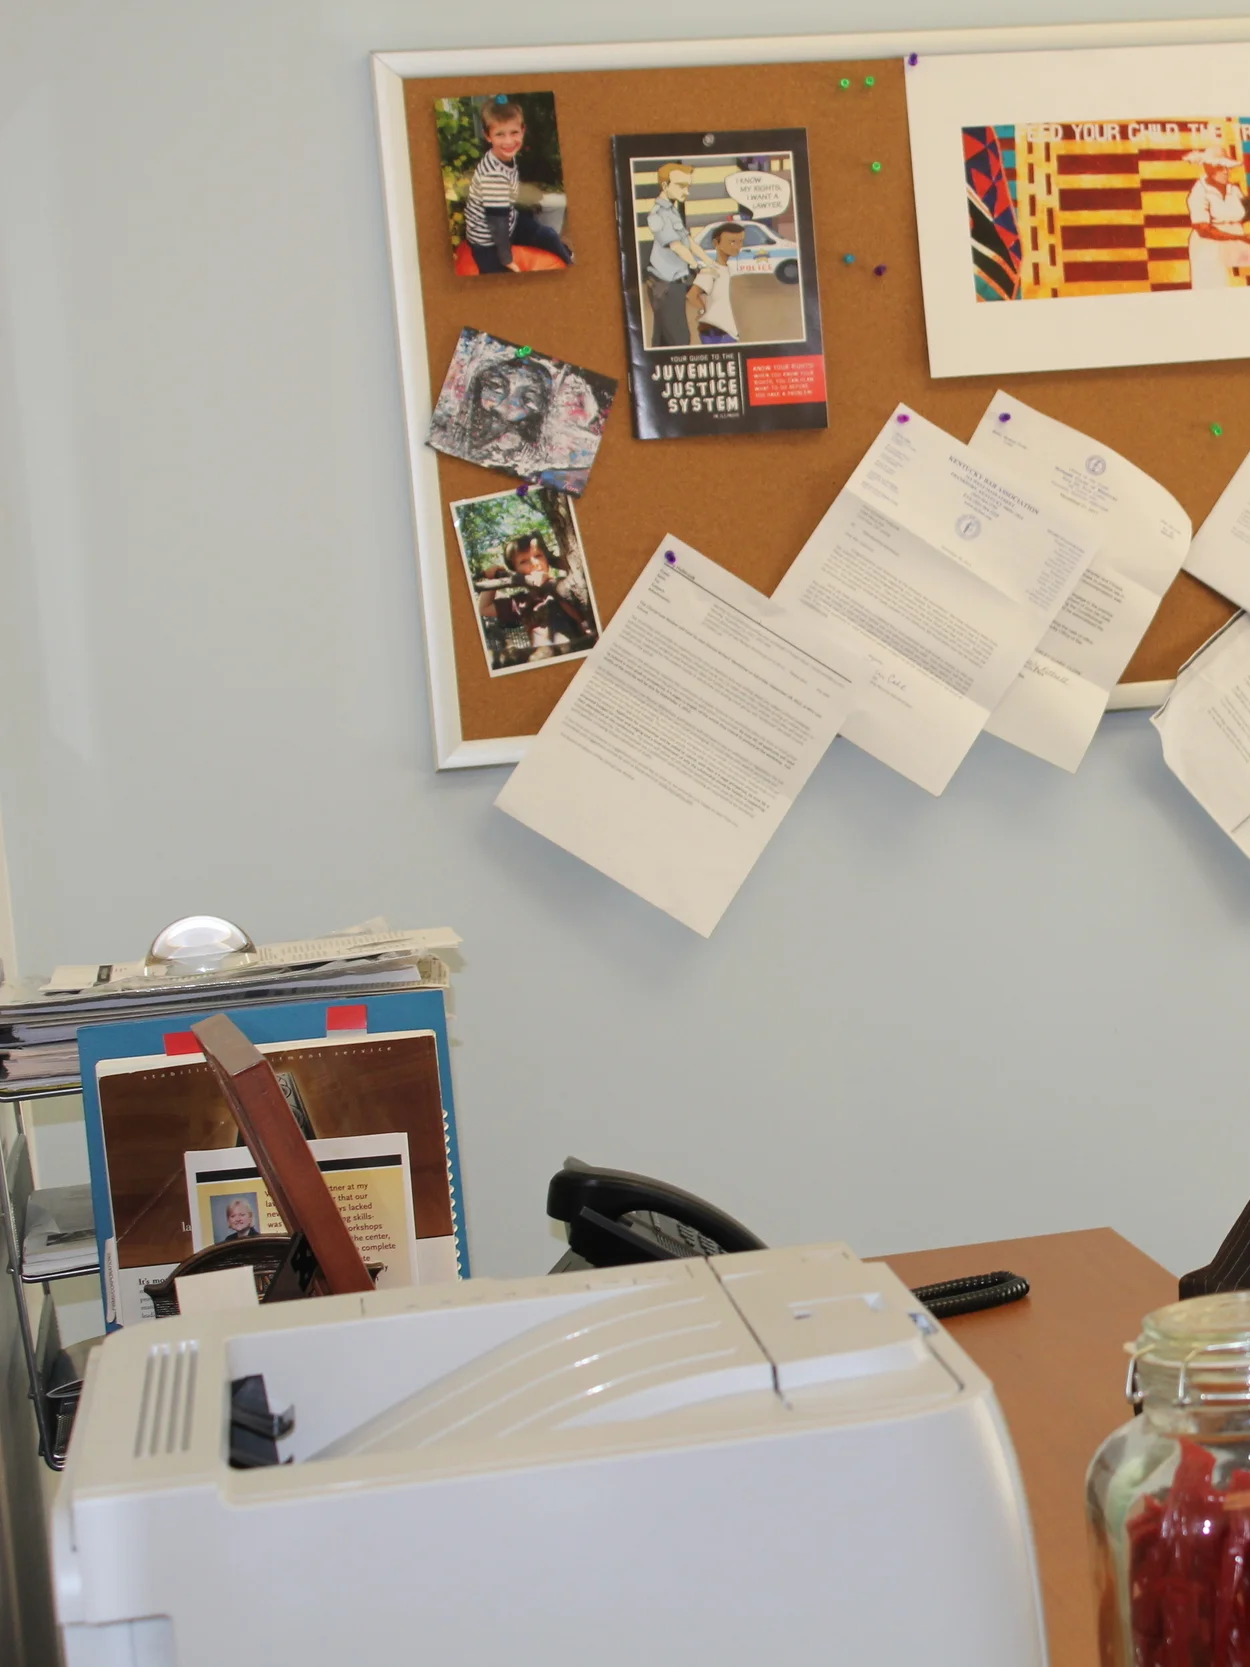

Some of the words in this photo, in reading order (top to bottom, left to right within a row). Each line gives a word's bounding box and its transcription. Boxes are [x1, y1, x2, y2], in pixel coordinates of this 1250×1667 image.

[1071, 123, 1121, 141] YOUR
[1128, 122, 1180, 142] CHILD
[1187, 122, 1223, 142] THE
[740, 176, 761, 184] KNOW
[751, 193, 771, 201] WANT
[689, 354, 709, 362] GUIDE
[651, 361, 736, 381] JUVENILE
[661, 379, 737, 398] JUSTICE
[667, 395, 739, 414] SYSTEM
[334, 1046, 393, 1057] service
[356, 1183, 368, 1191] my
[338, 1193, 353, 1201] that
[349, 1202, 372, 1211] lacked
[348, 1223, 382, 1232] orkshops
[365, 1233, 391, 1241] center,
[361, 1243, 396, 1252] complete
